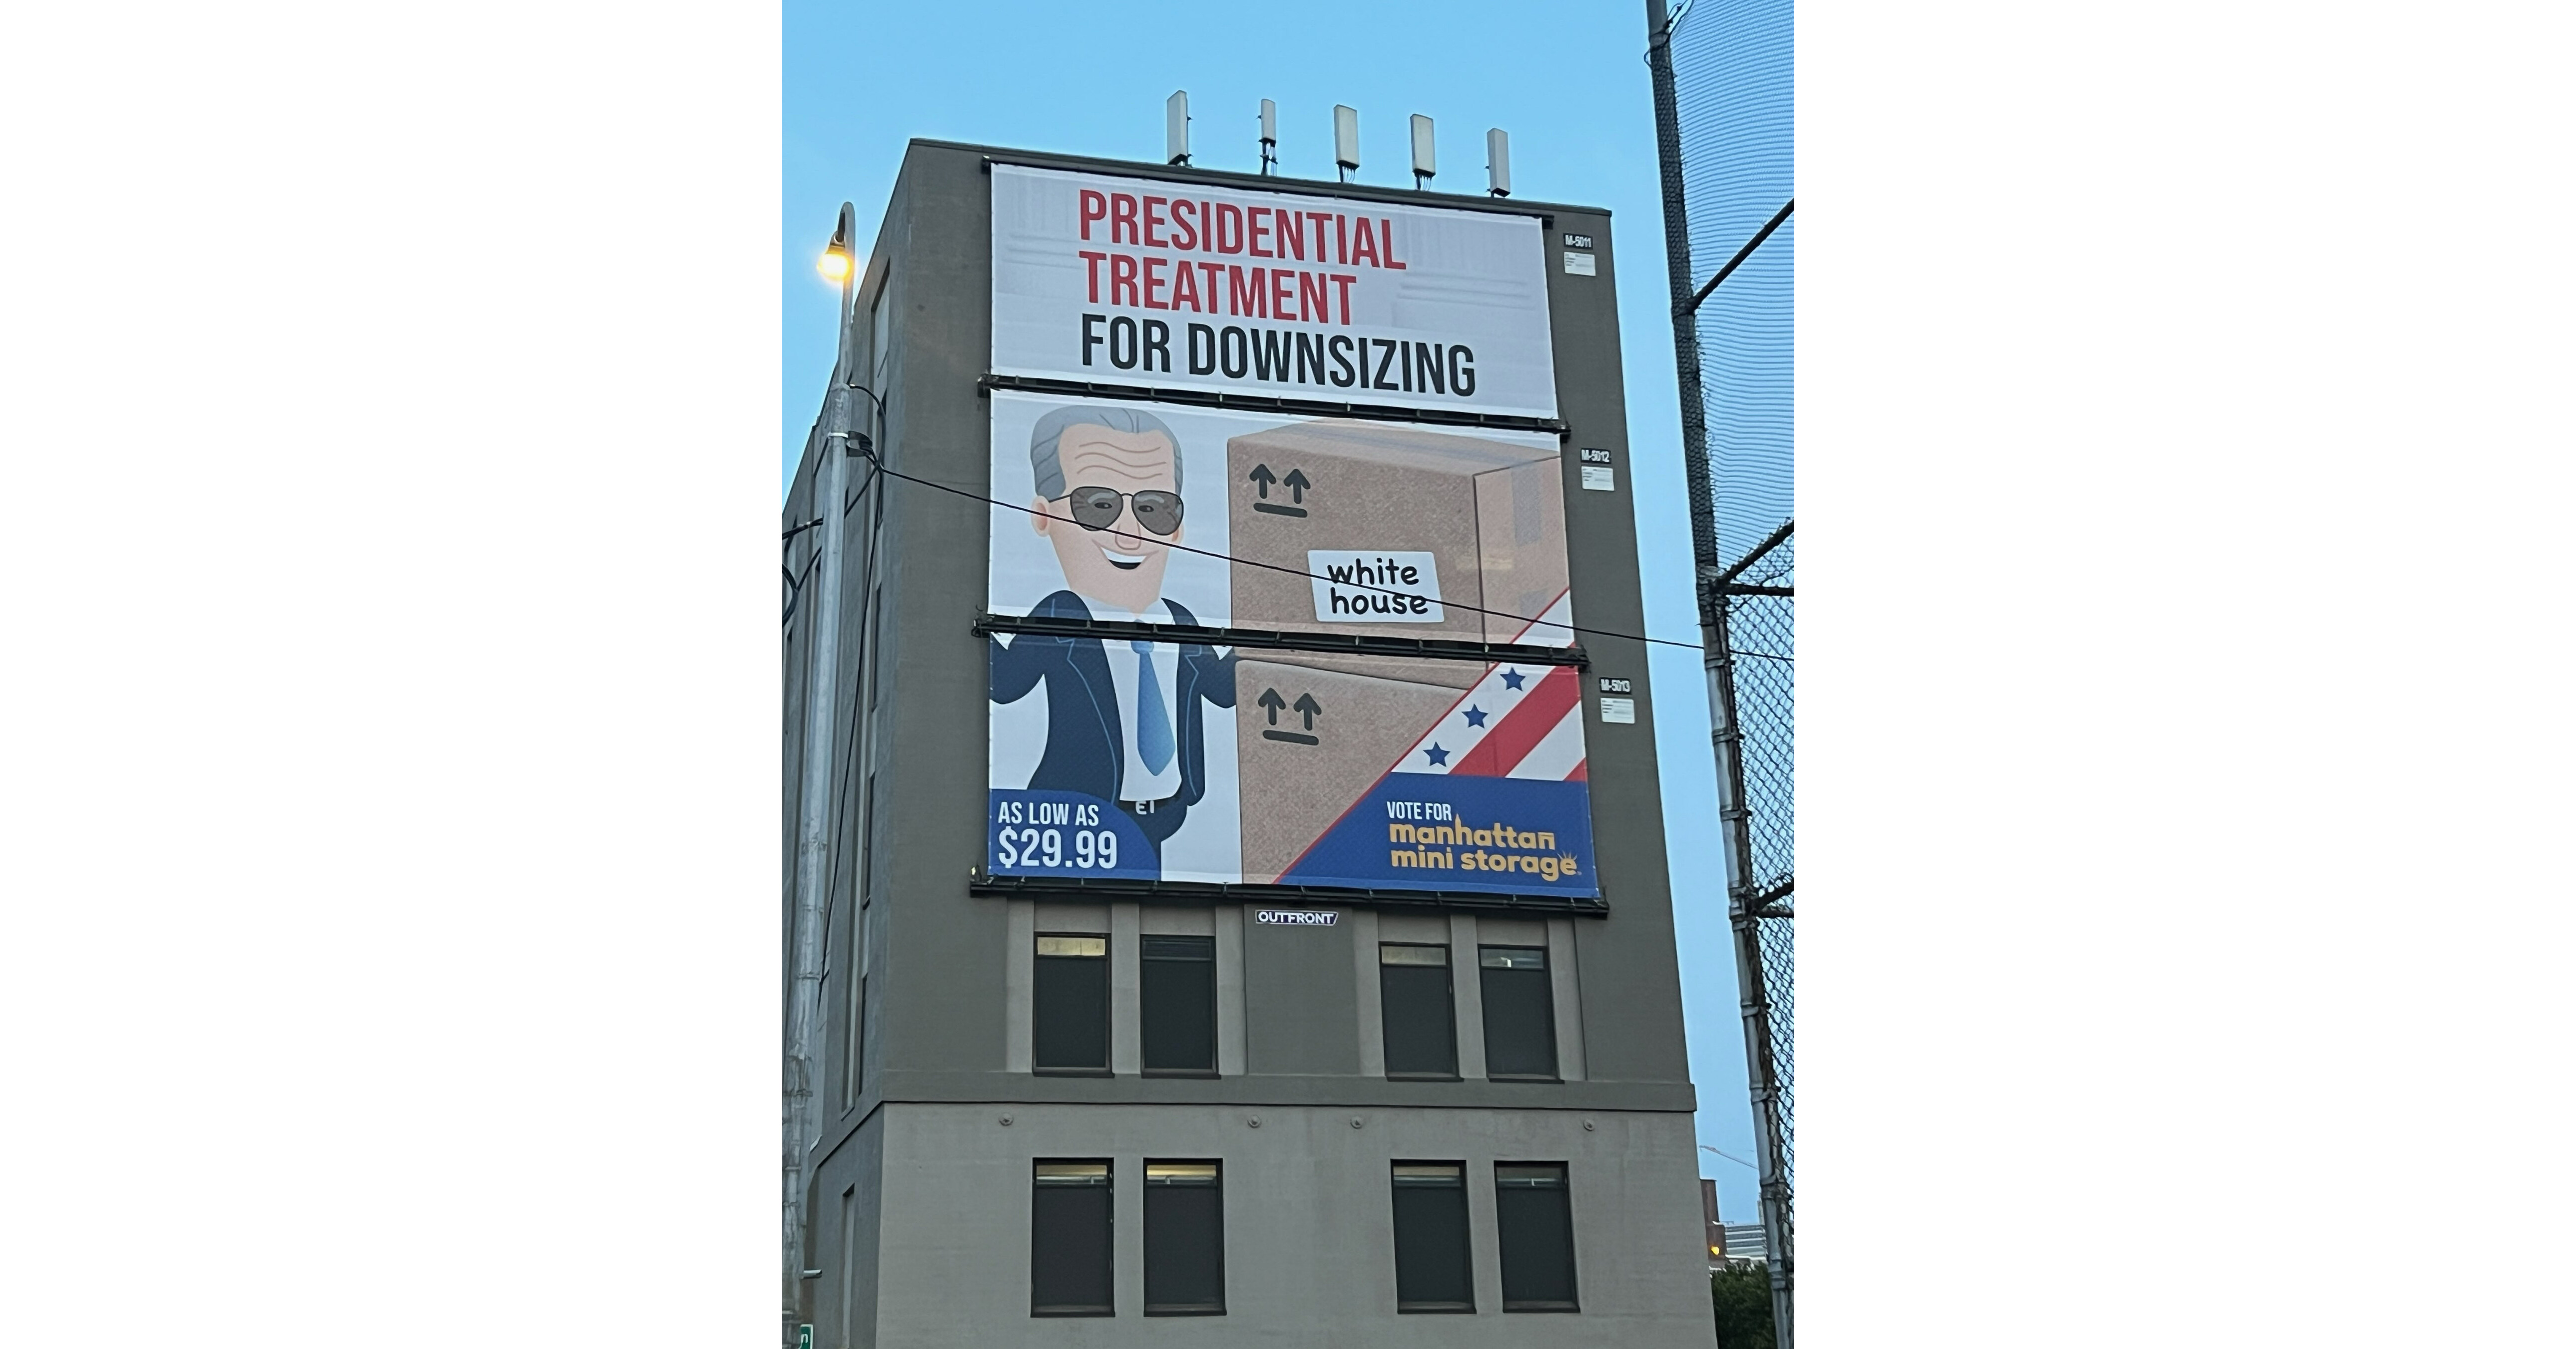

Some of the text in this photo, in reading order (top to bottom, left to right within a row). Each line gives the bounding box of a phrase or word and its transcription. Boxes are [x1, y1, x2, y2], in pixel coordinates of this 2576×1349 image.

[1080, 189, 1407, 270] PRESIDENTIAL
[1079, 251, 1357, 325] TREATMENT
[1081, 313, 1476, 396] FOR DOWNSIZING
[1327, 558, 1419, 585] white
[1330, 587, 1429, 615] house
[998, 801, 1099, 826] AS LOW AS
[1387, 801, 1452, 821] VOTE FOR
[999, 826, 1117, 869] $29.99
[1389, 813, 1555, 850] manhattan
[1391, 845, 1577, 882] mini storage
[1258, 911, 1334, 924] OUTFRONT
